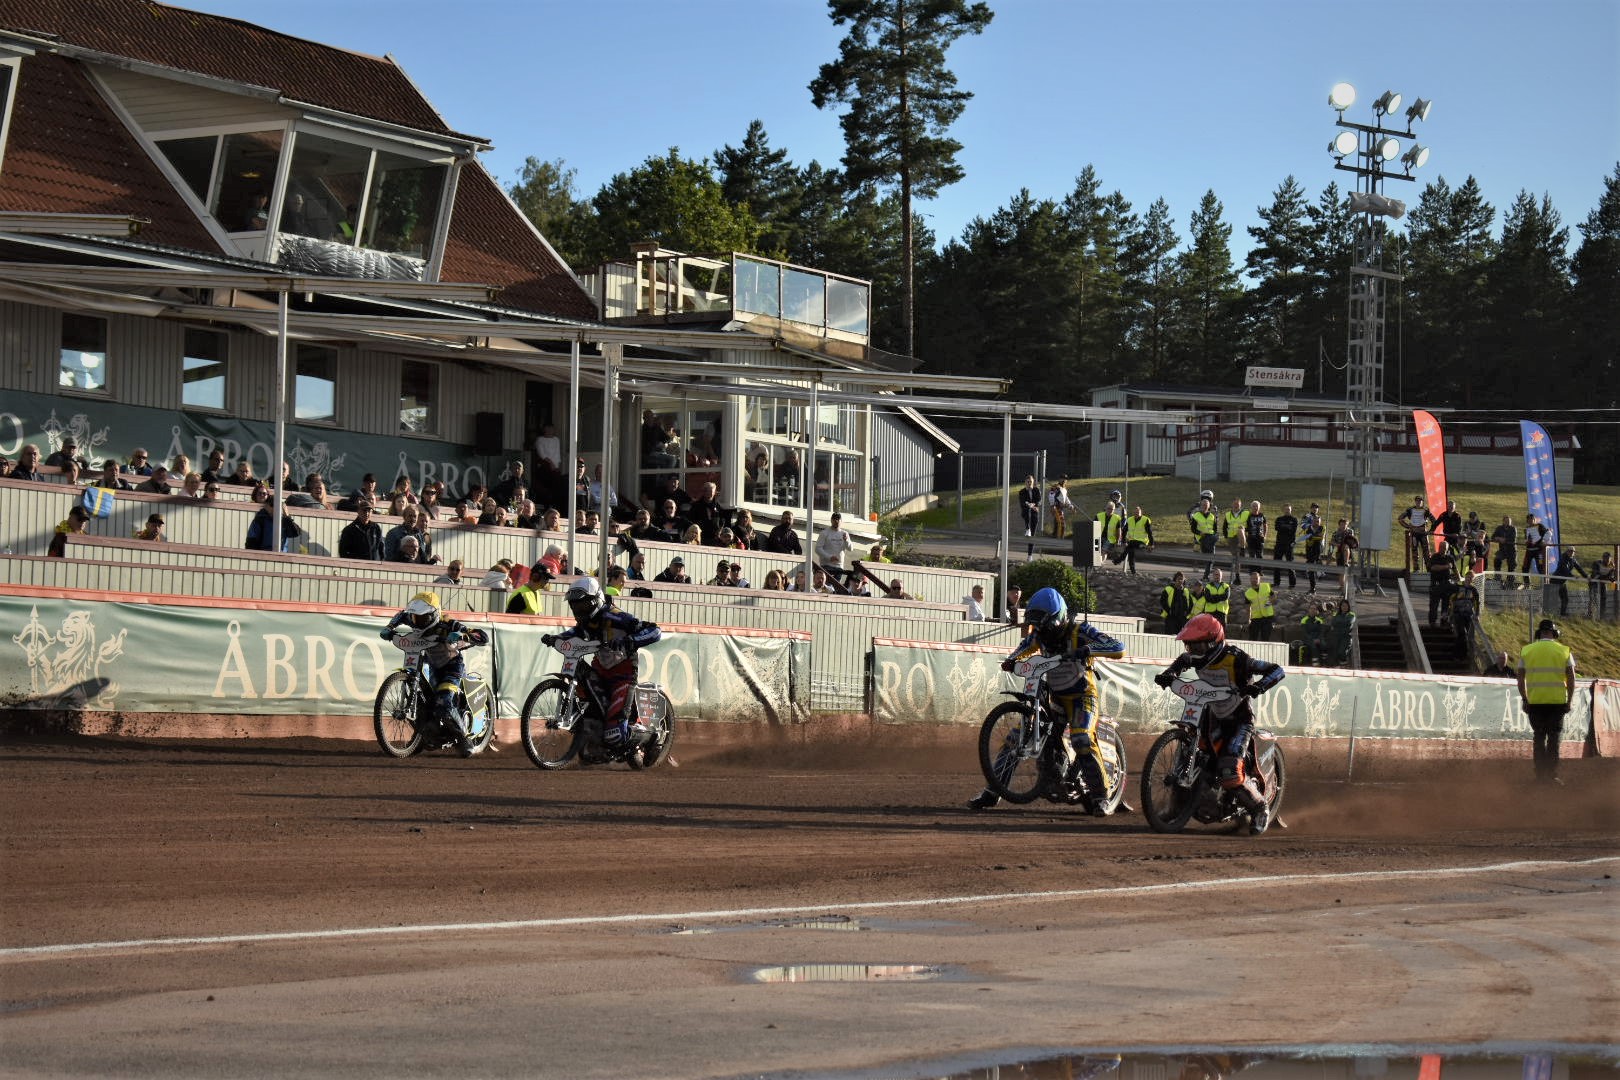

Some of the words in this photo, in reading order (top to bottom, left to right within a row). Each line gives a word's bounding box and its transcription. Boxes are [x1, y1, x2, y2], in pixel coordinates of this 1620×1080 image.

[1248, 369, 1302, 381] Stensåkra
[211, 619, 385, 702] ÅBRO
[880, 660, 935, 714] RO
[1254, 685, 1293, 728] RO
[1369, 682, 1435, 731] ÅBRO
[1500, 688, 1534, 733] ÅB
